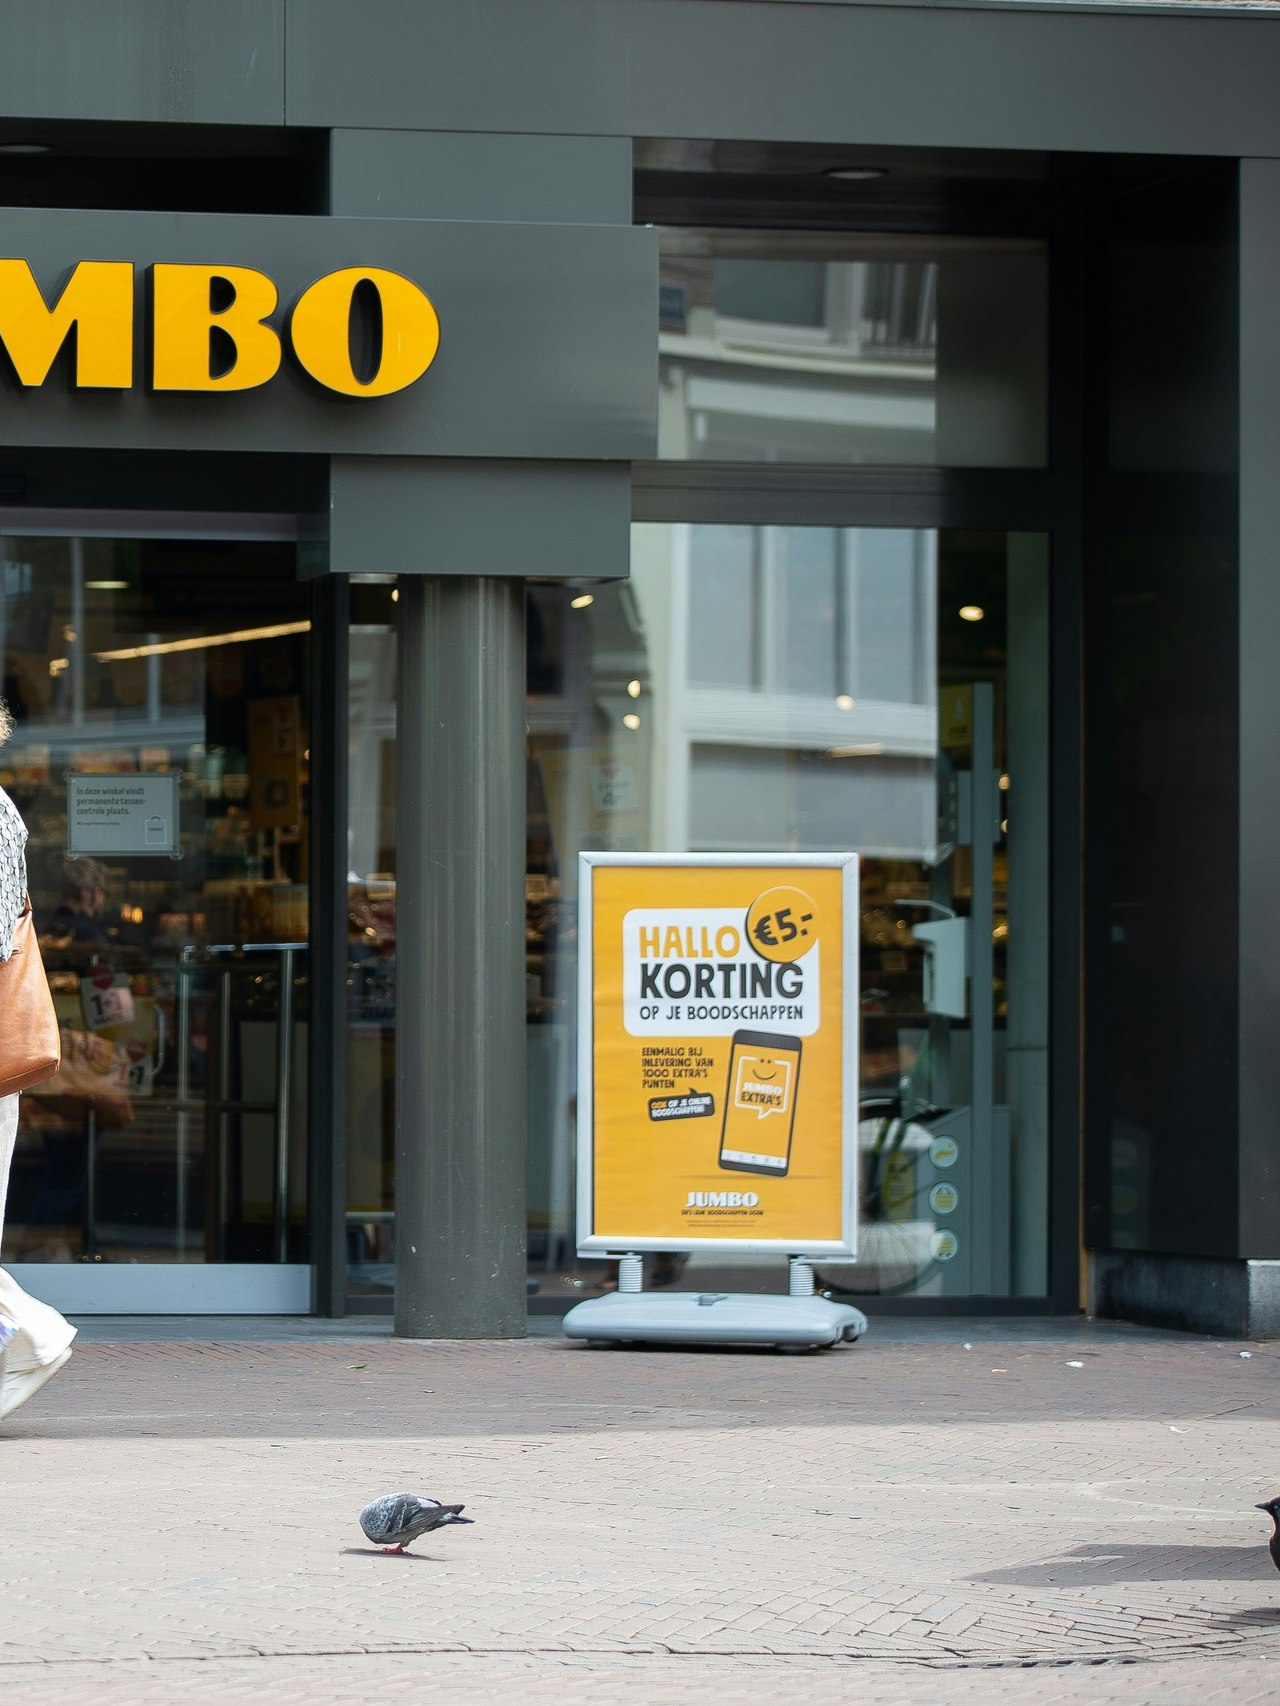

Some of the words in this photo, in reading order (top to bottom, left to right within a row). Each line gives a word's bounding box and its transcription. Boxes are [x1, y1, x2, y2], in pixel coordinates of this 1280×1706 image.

[76, 786, 83, 795] In
[85, 786, 100, 795] deze
[102, 786, 125, 795] winkel
[126, 786, 145, 795] vindt
[76, 798, 119, 807] permanente
[76, 807, 105, 815] controle
[106, 807, 131, 816] plaats.
[639, 925, 741, 959] HALLO
[640, 962, 804, 999] KORTING
[640, 1005, 659, 1020] OP
[666, 1005, 681, 1020] JE
[687, 1004, 803, 1020] BOODSCHAPPEN
[642, 1047, 685, 1056] EENMALIG
[688, 1047, 703, 1056] BIJ
[642, 1058, 692, 1067] INLEVERING
[695, 1058, 714, 1067] VAN
[642, 1068, 669, 1078] 1000
[672, 1068, 708, 1078] EXTRA'S
[642, 1079, 675, 1088] PUNTEN
[740, 1091, 782, 1106] EXTRA'S
[651, 1105, 706, 1118] BOODSCHAPPEN
[685, 1191, 759, 1208] JUMBO
